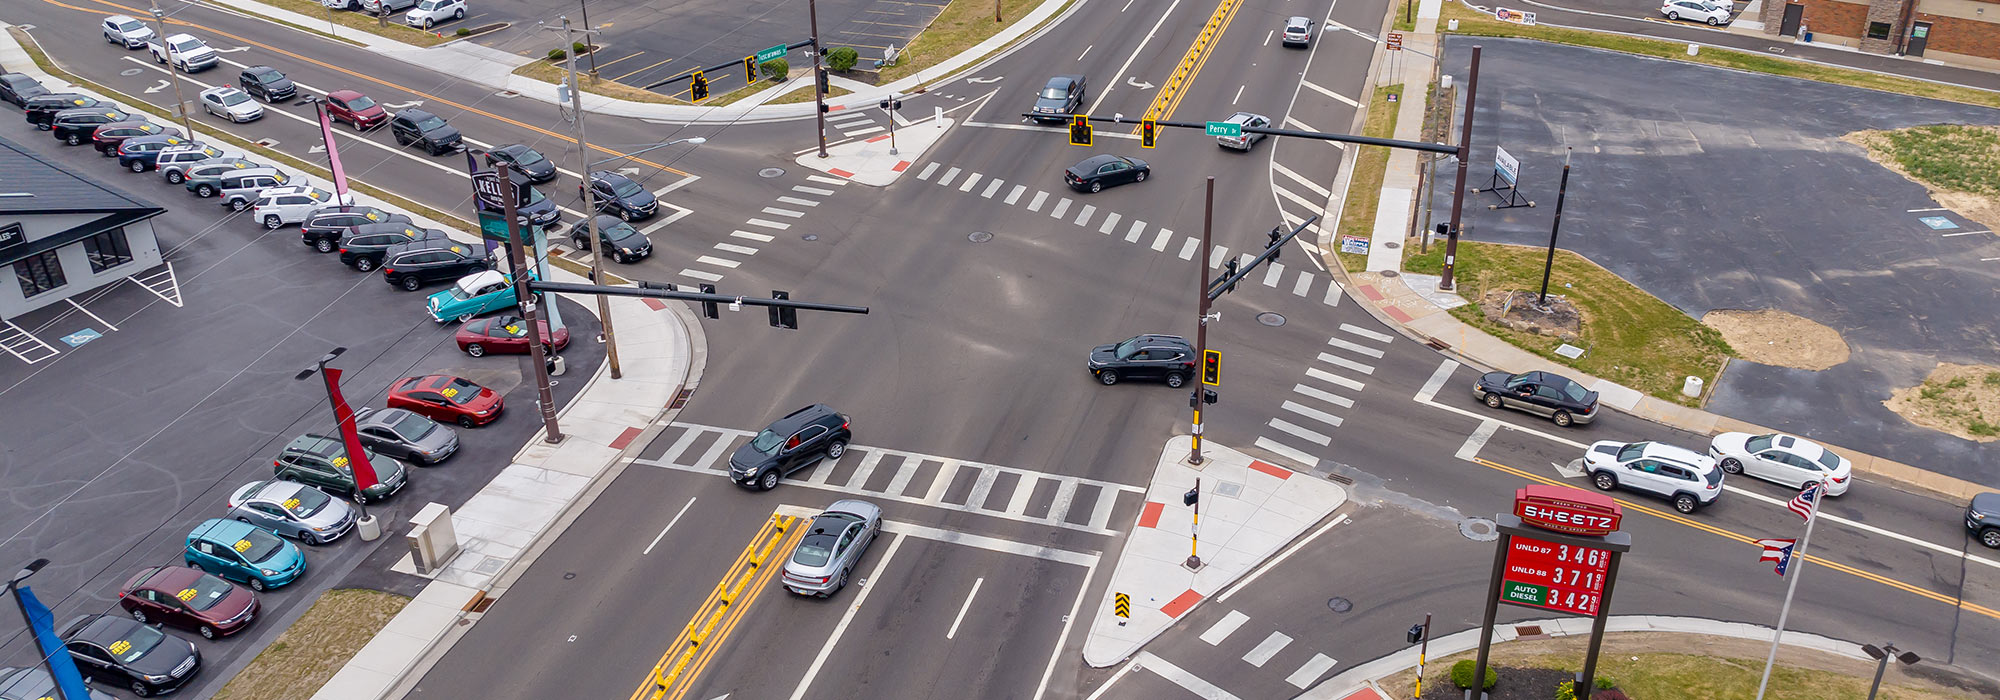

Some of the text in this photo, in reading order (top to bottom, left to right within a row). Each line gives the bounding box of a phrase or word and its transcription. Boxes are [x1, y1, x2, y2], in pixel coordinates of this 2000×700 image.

[1209, 125, 1228, 134] Perry
[1524, 505, 1612, 528] SHEETZ
[1515, 543, 1540, 553] UNLD
[1540, 547, 1552, 555] 87
[1511, 565, 1536, 575] UNLD
[1536, 569, 1547, 577] 88
[1514, 585, 1538, 594] AUTO
[1510, 591, 1538, 602] DIESEL
